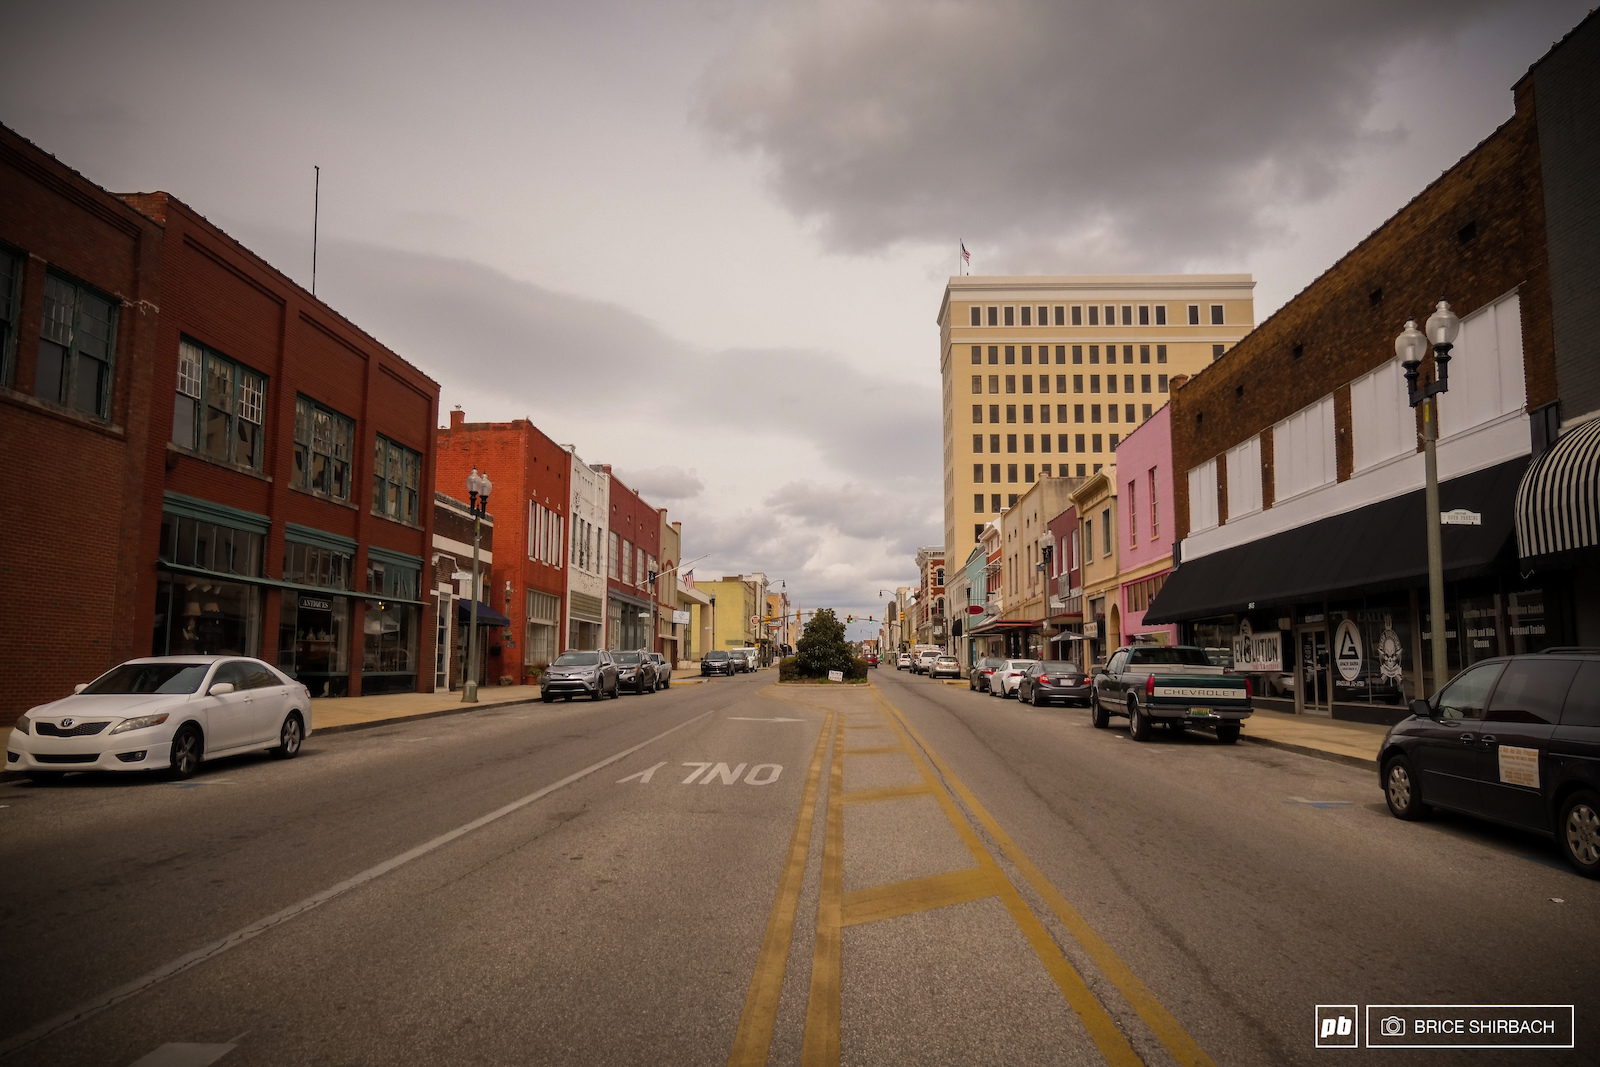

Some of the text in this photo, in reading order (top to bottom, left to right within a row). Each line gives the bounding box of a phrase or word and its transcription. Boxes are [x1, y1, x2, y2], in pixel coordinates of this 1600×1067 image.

[302, 599, 329, 608] ANTIQUES
[1467, 629, 1477, 637] Adult
[1486, 628, 1495, 637] Kids
[1510, 626, 1530, 635] Personal
[1474, 640, 1489, 648] Classes
[1163, 689, 1237, 697] CHEVROLET
